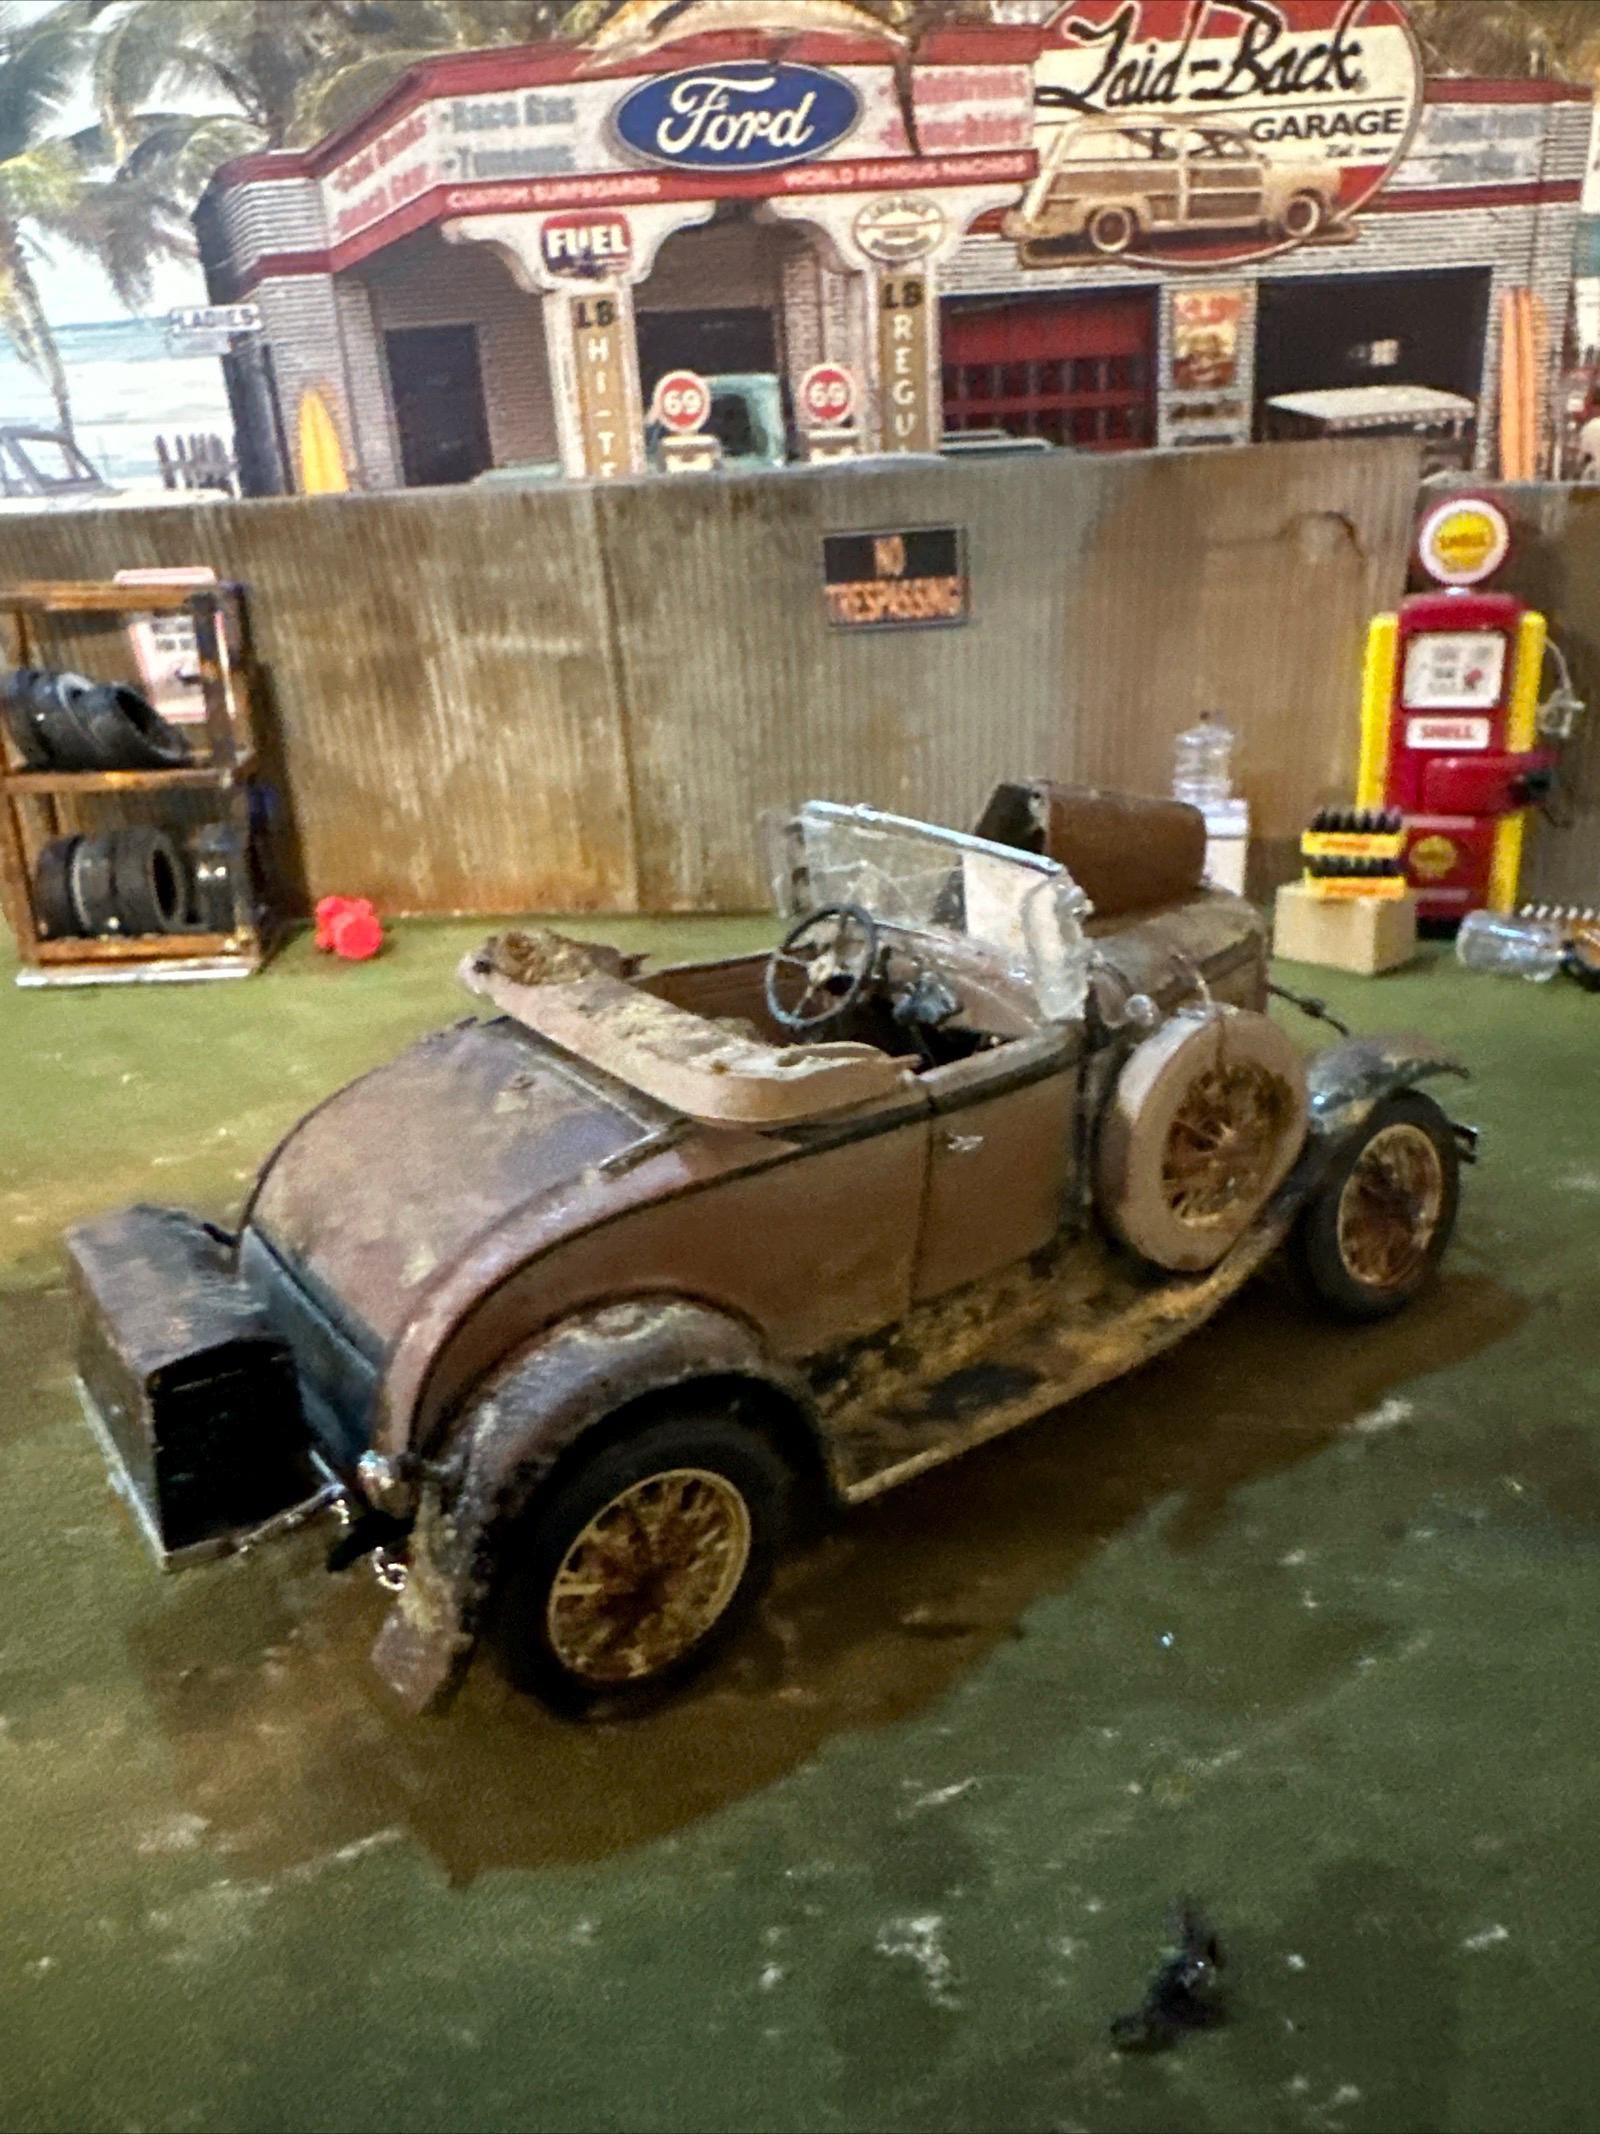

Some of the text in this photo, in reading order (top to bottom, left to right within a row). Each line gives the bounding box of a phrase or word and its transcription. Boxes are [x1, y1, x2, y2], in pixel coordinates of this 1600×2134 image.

[1034, 0, 1365, 116] Laid-Back
[656, 77, 817, 154] Ford
[1250, 108, 1402, 143] GARAGE
[547, 224, 632, 258] FUEL
[892, 315, 917, 454] REGU
